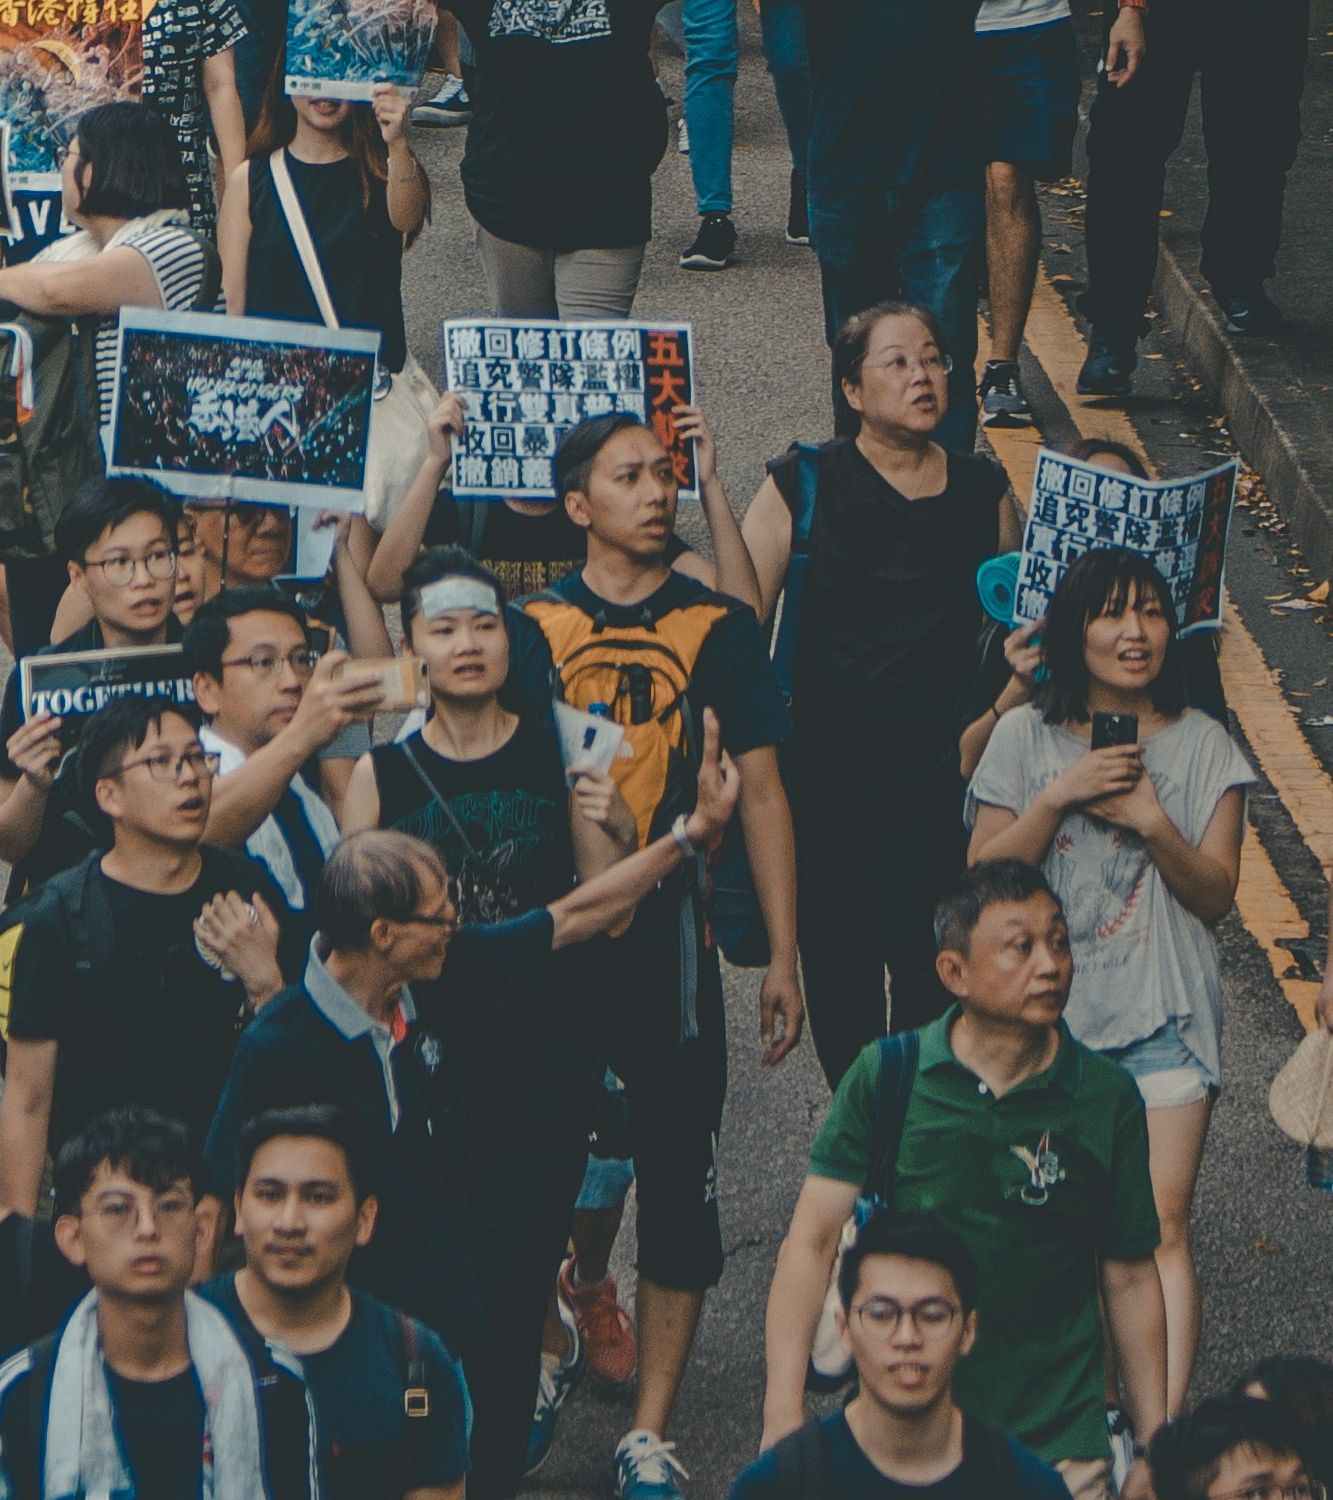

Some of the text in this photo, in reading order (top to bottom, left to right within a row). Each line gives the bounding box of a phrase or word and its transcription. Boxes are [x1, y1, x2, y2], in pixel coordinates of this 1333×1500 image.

[451, 328, 644, 361] 撤回修訂條例
[451, 360, 645, 391] 追究警隊濫權
[457, 422, 552, 456] 收回暴
[1038, 461, 1206, 519] 撤回修訂條例
